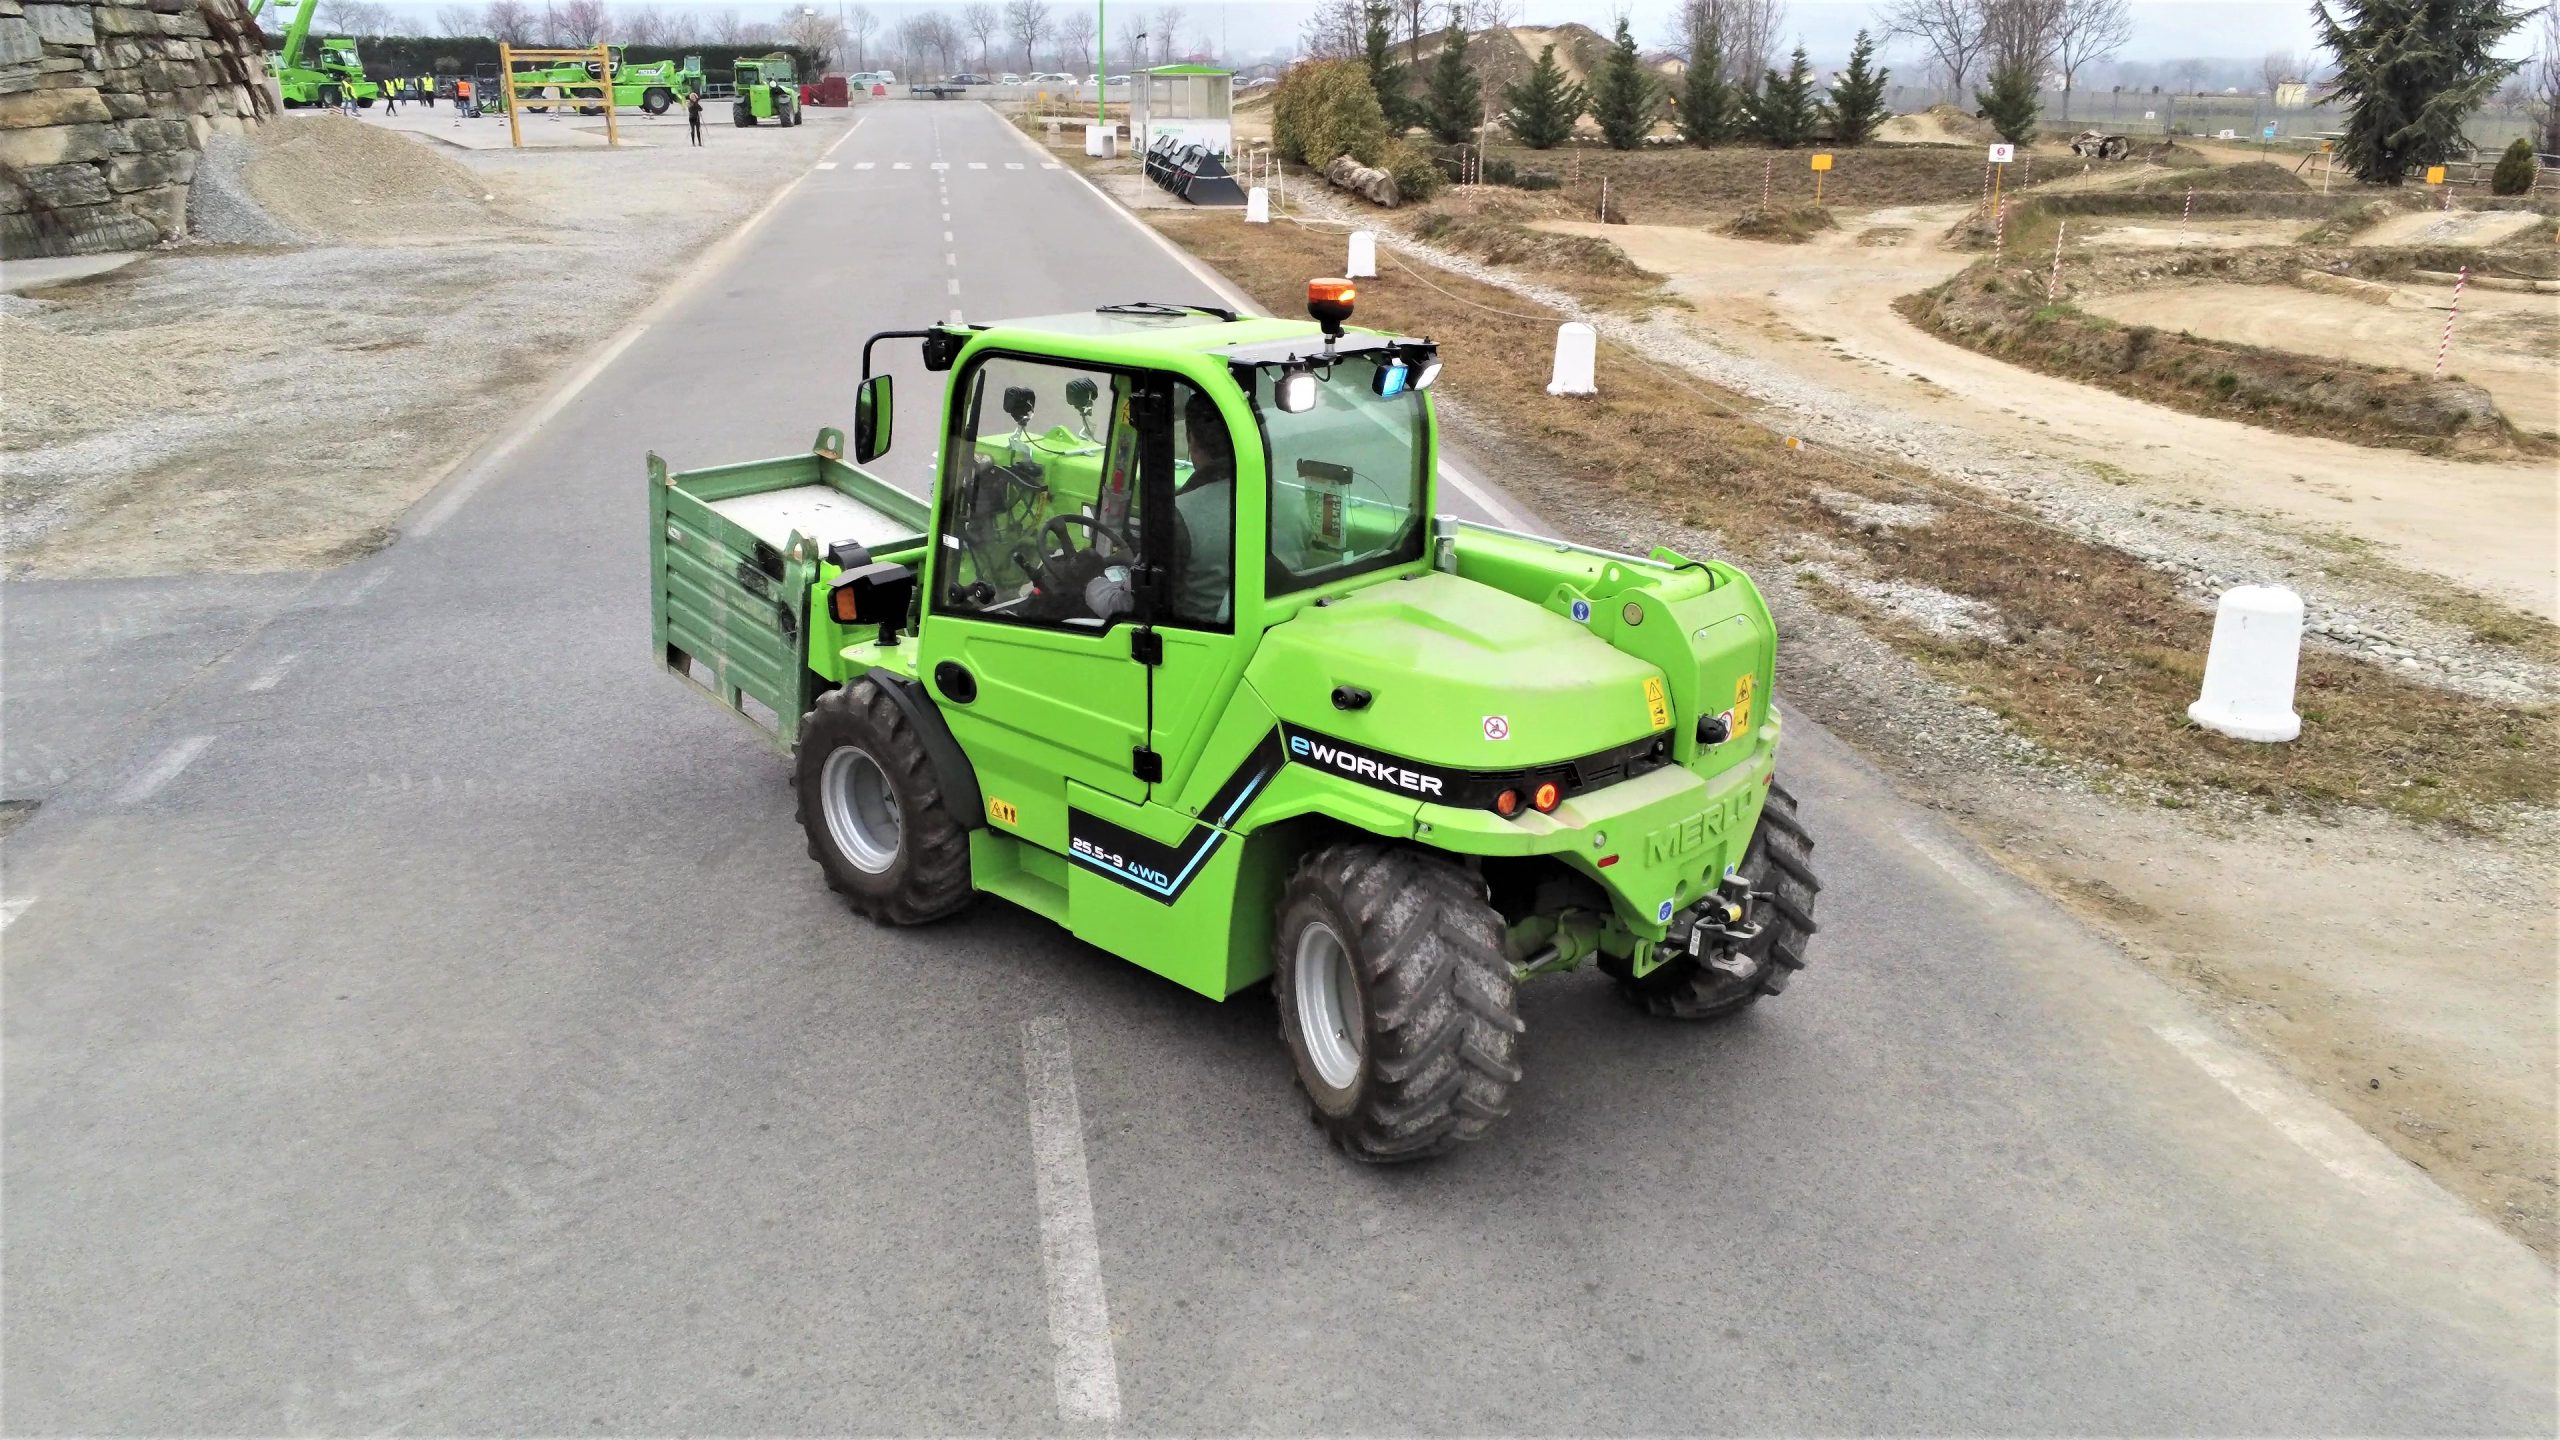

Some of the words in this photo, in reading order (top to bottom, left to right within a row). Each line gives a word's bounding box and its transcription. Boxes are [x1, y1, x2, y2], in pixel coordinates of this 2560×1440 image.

[1291, 736, 1443, 796] eWORKER
[1645, 783, 1752, 868] MERLO
[1073, 837, 1123, 868] 25.5-9
[1128, 862, 1168, 887] 4WD
